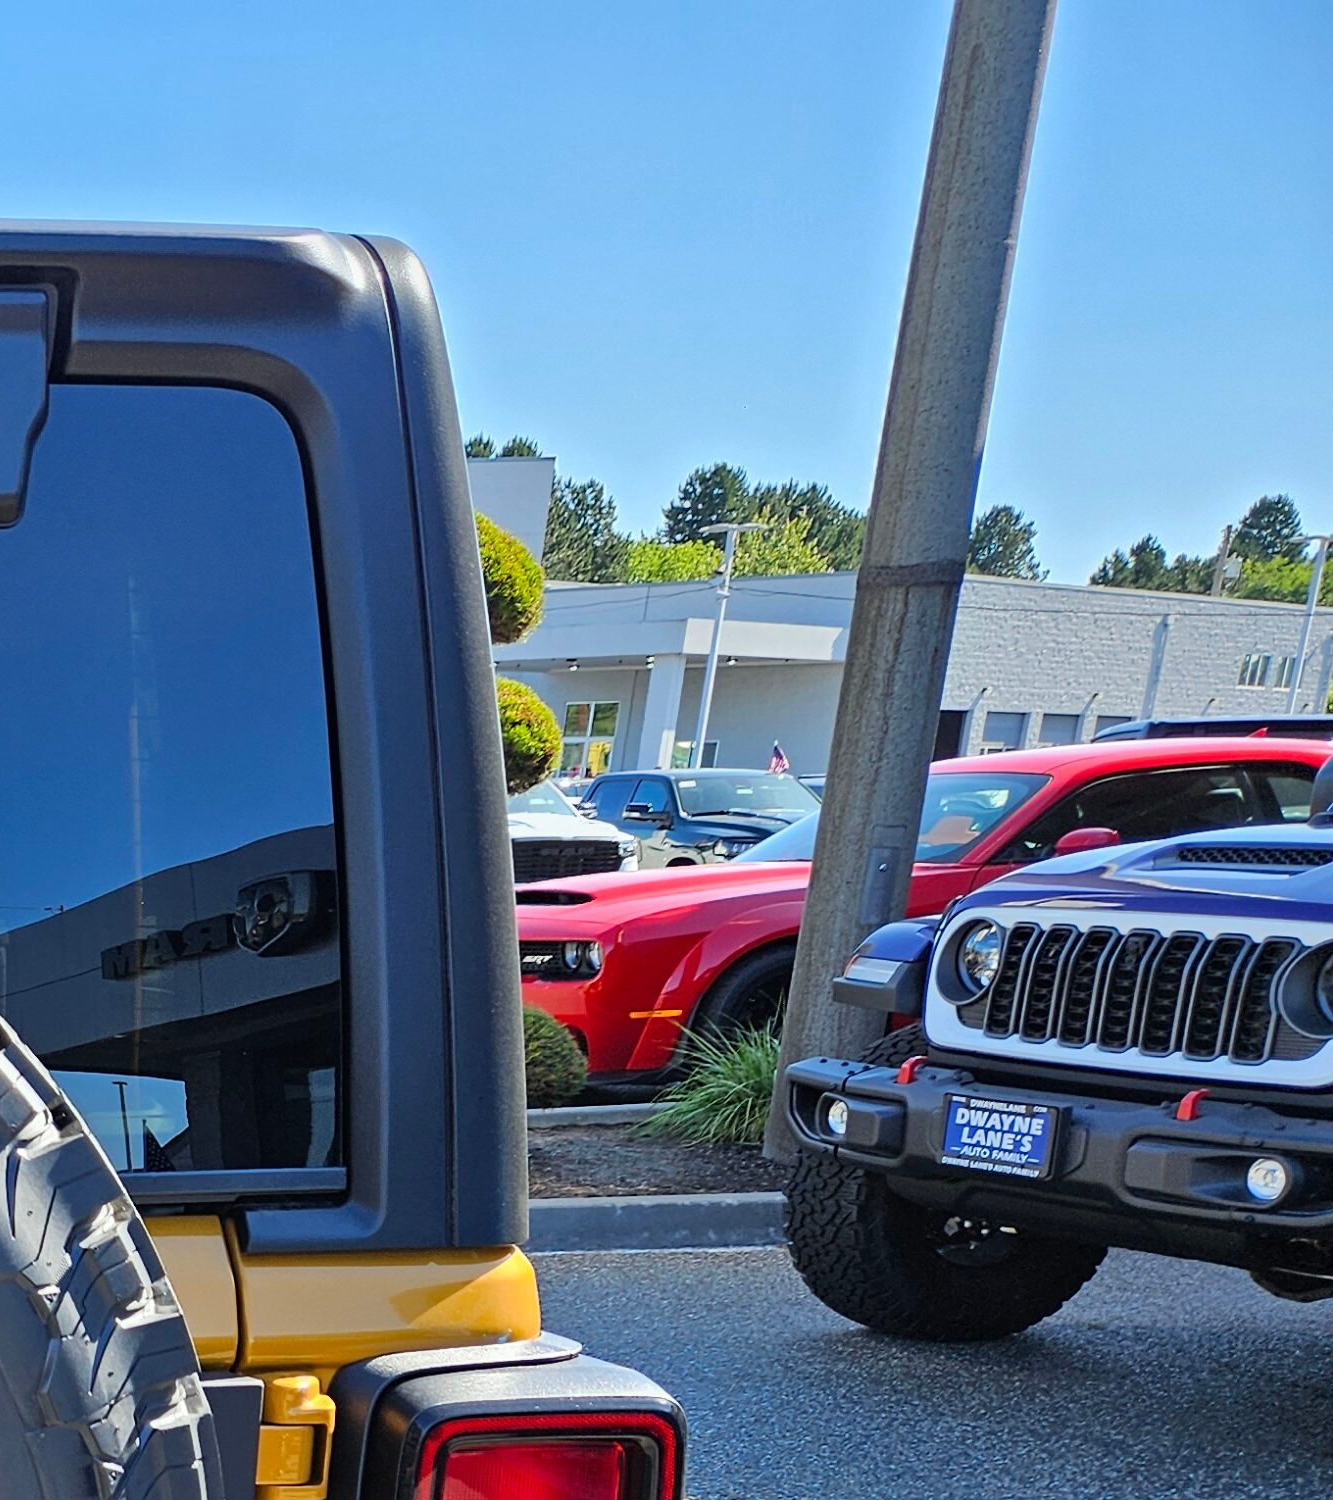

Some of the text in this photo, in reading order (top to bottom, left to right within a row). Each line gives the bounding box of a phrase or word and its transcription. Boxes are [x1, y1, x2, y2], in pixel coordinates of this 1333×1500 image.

[955, 1107, 1045, 1136] DWAYNE
[960, 1126, 1033, 1153] LANE'S
[960, 1145, 1029, 1164] AUTO FAMILY
